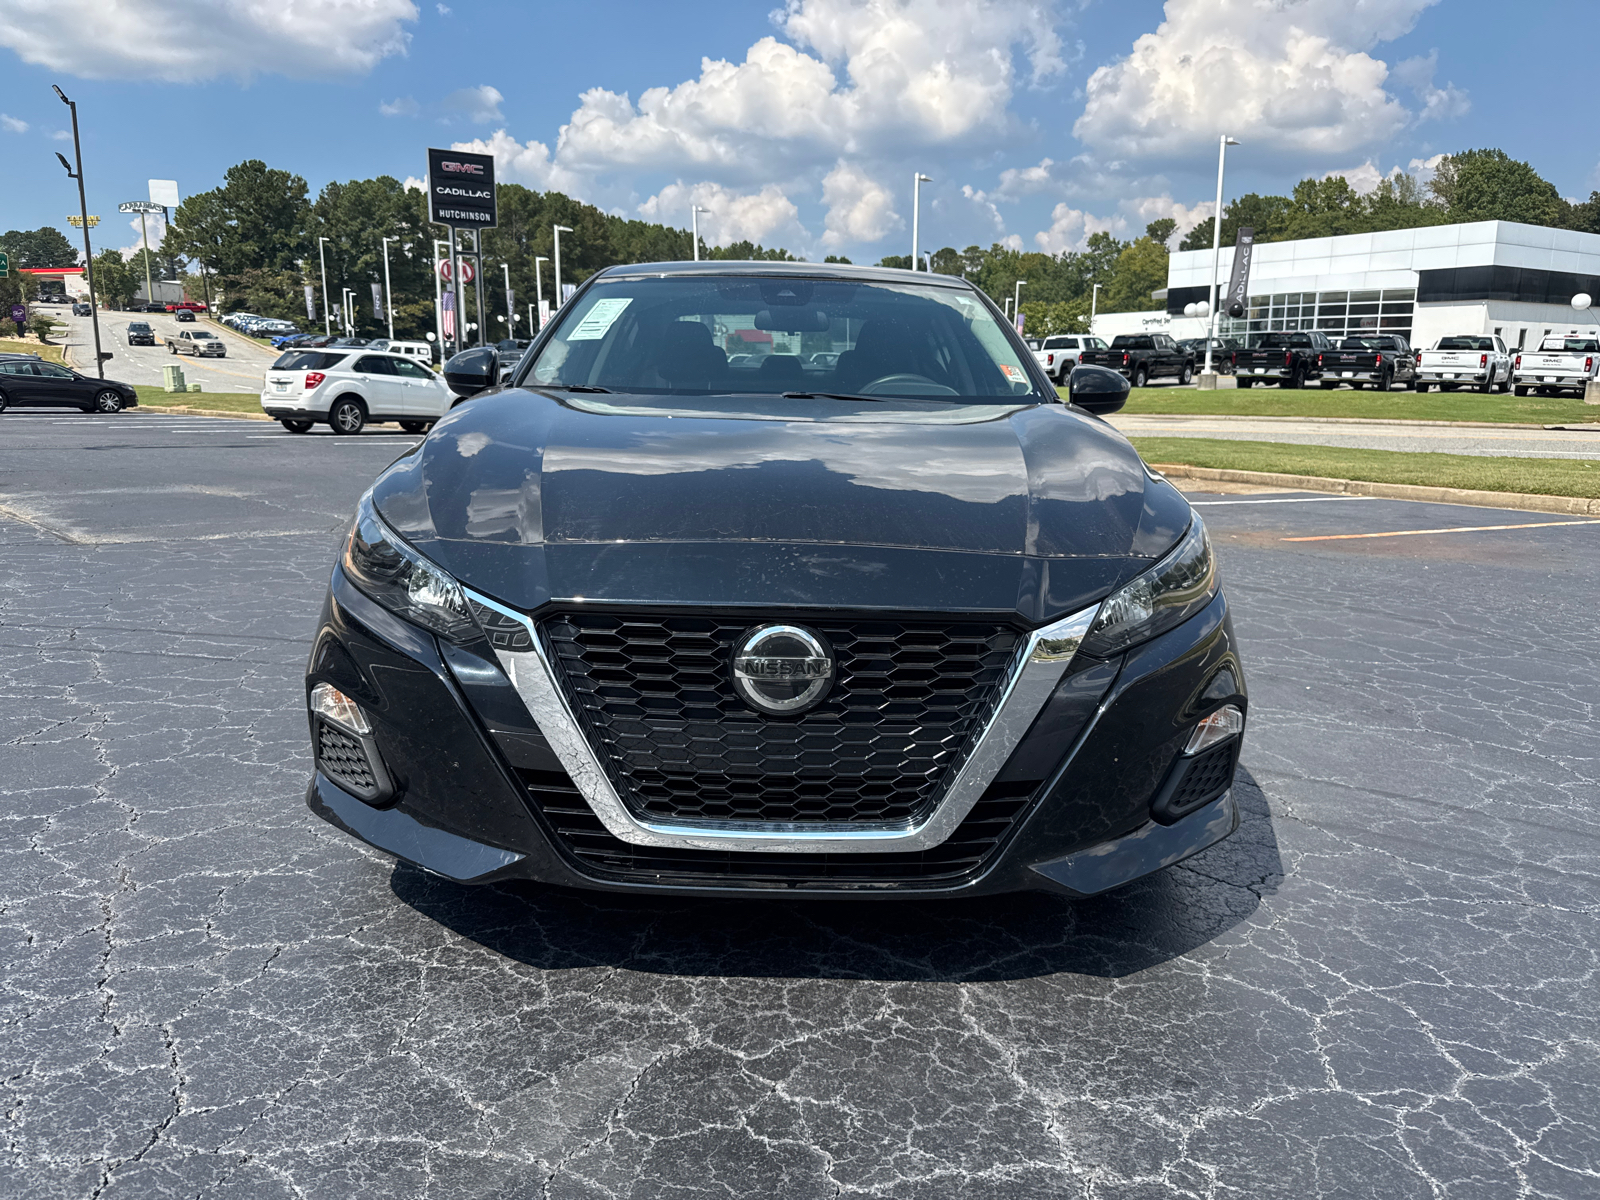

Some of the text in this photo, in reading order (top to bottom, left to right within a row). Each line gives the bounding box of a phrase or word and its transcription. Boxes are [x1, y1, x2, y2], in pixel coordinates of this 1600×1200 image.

[441, 161, 484, 175] GMC
[436, 186, 491, 199] CADILLAC
[439, 209, 491, 221] HUTCHINSON
[1236, 247, 1250, 303] ADILLAC
[744, 661, 821, 675] NISSAN
